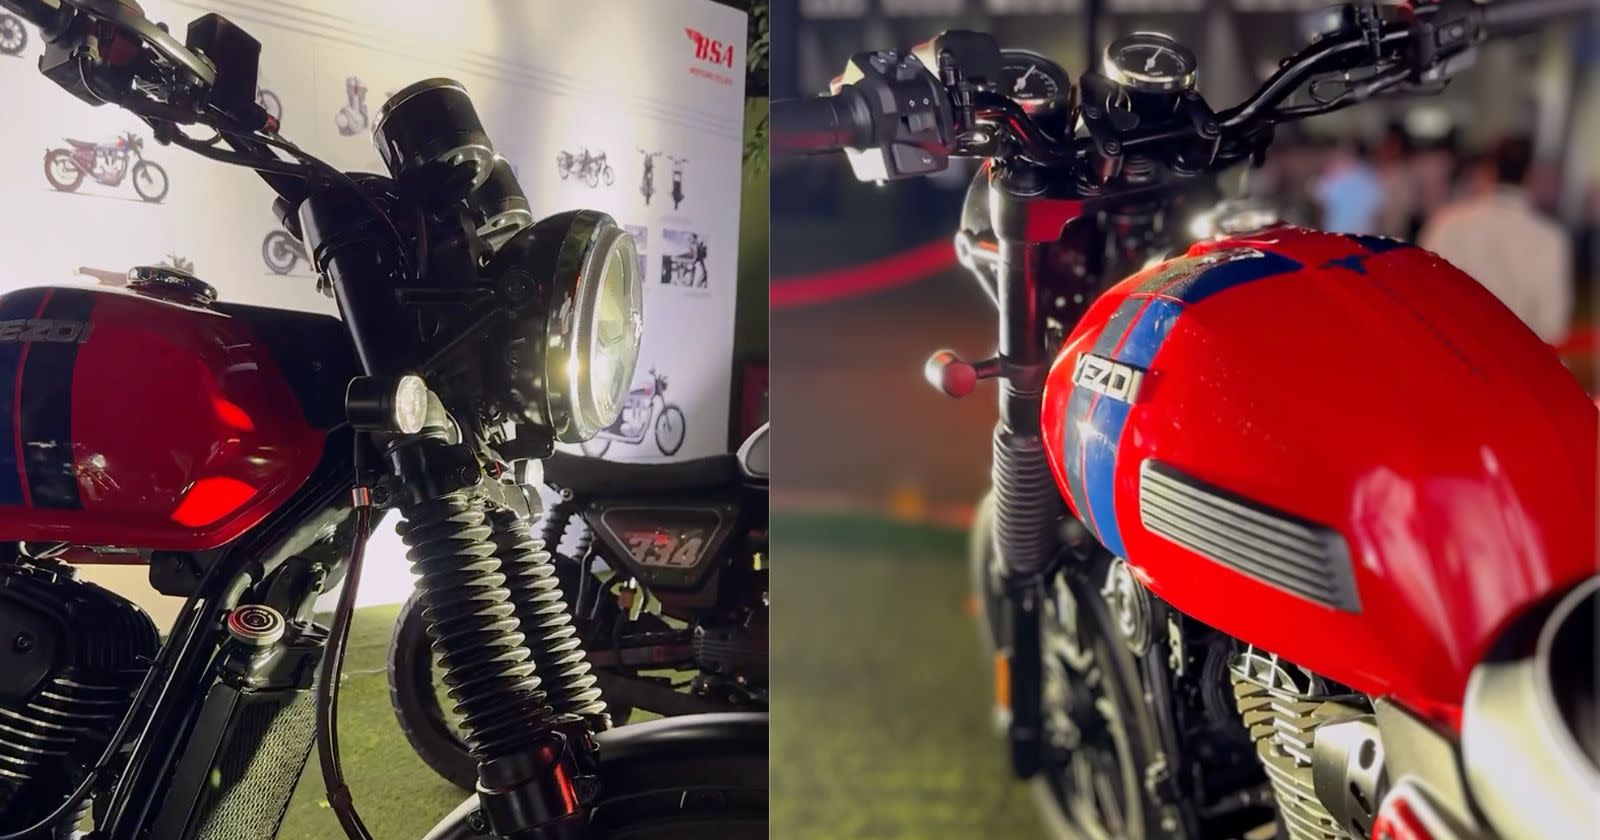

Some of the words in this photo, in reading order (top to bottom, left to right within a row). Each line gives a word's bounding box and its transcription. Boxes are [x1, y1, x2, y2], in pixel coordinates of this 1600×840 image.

[693, 33, 733, 68] BSA
[0, 319, 94, 343] EZDI
[1072, 352, 1143, 405] YEZDI
[626, 533, 702, 567] 334
